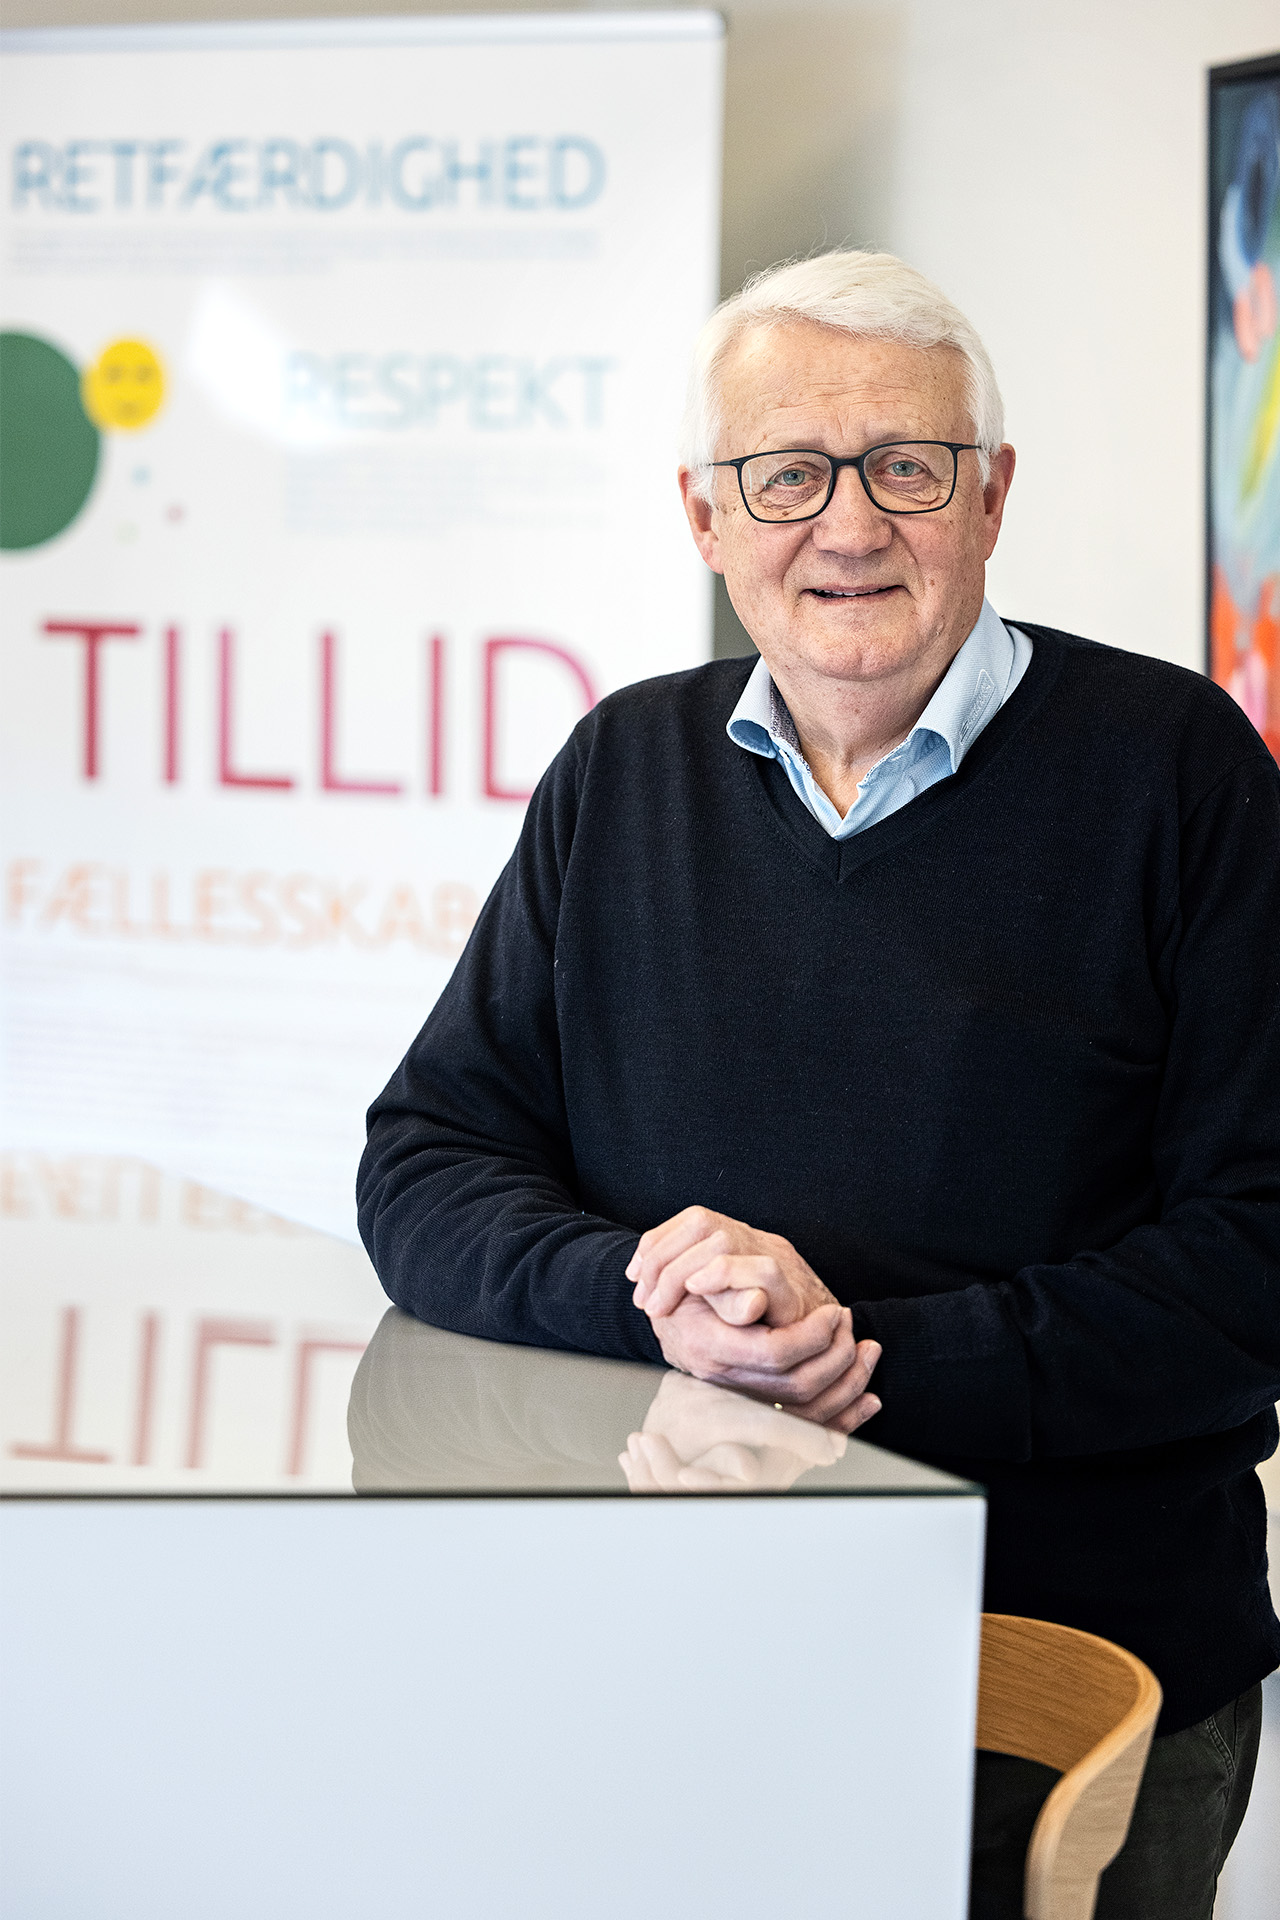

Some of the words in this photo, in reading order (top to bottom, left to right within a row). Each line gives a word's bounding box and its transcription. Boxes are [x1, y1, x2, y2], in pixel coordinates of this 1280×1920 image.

[11, 135, 608, 213] RETFÆRDIGHED
[283, 350, 616, 430] RESPEKT
[40, 618, 604, 804] TILLID
